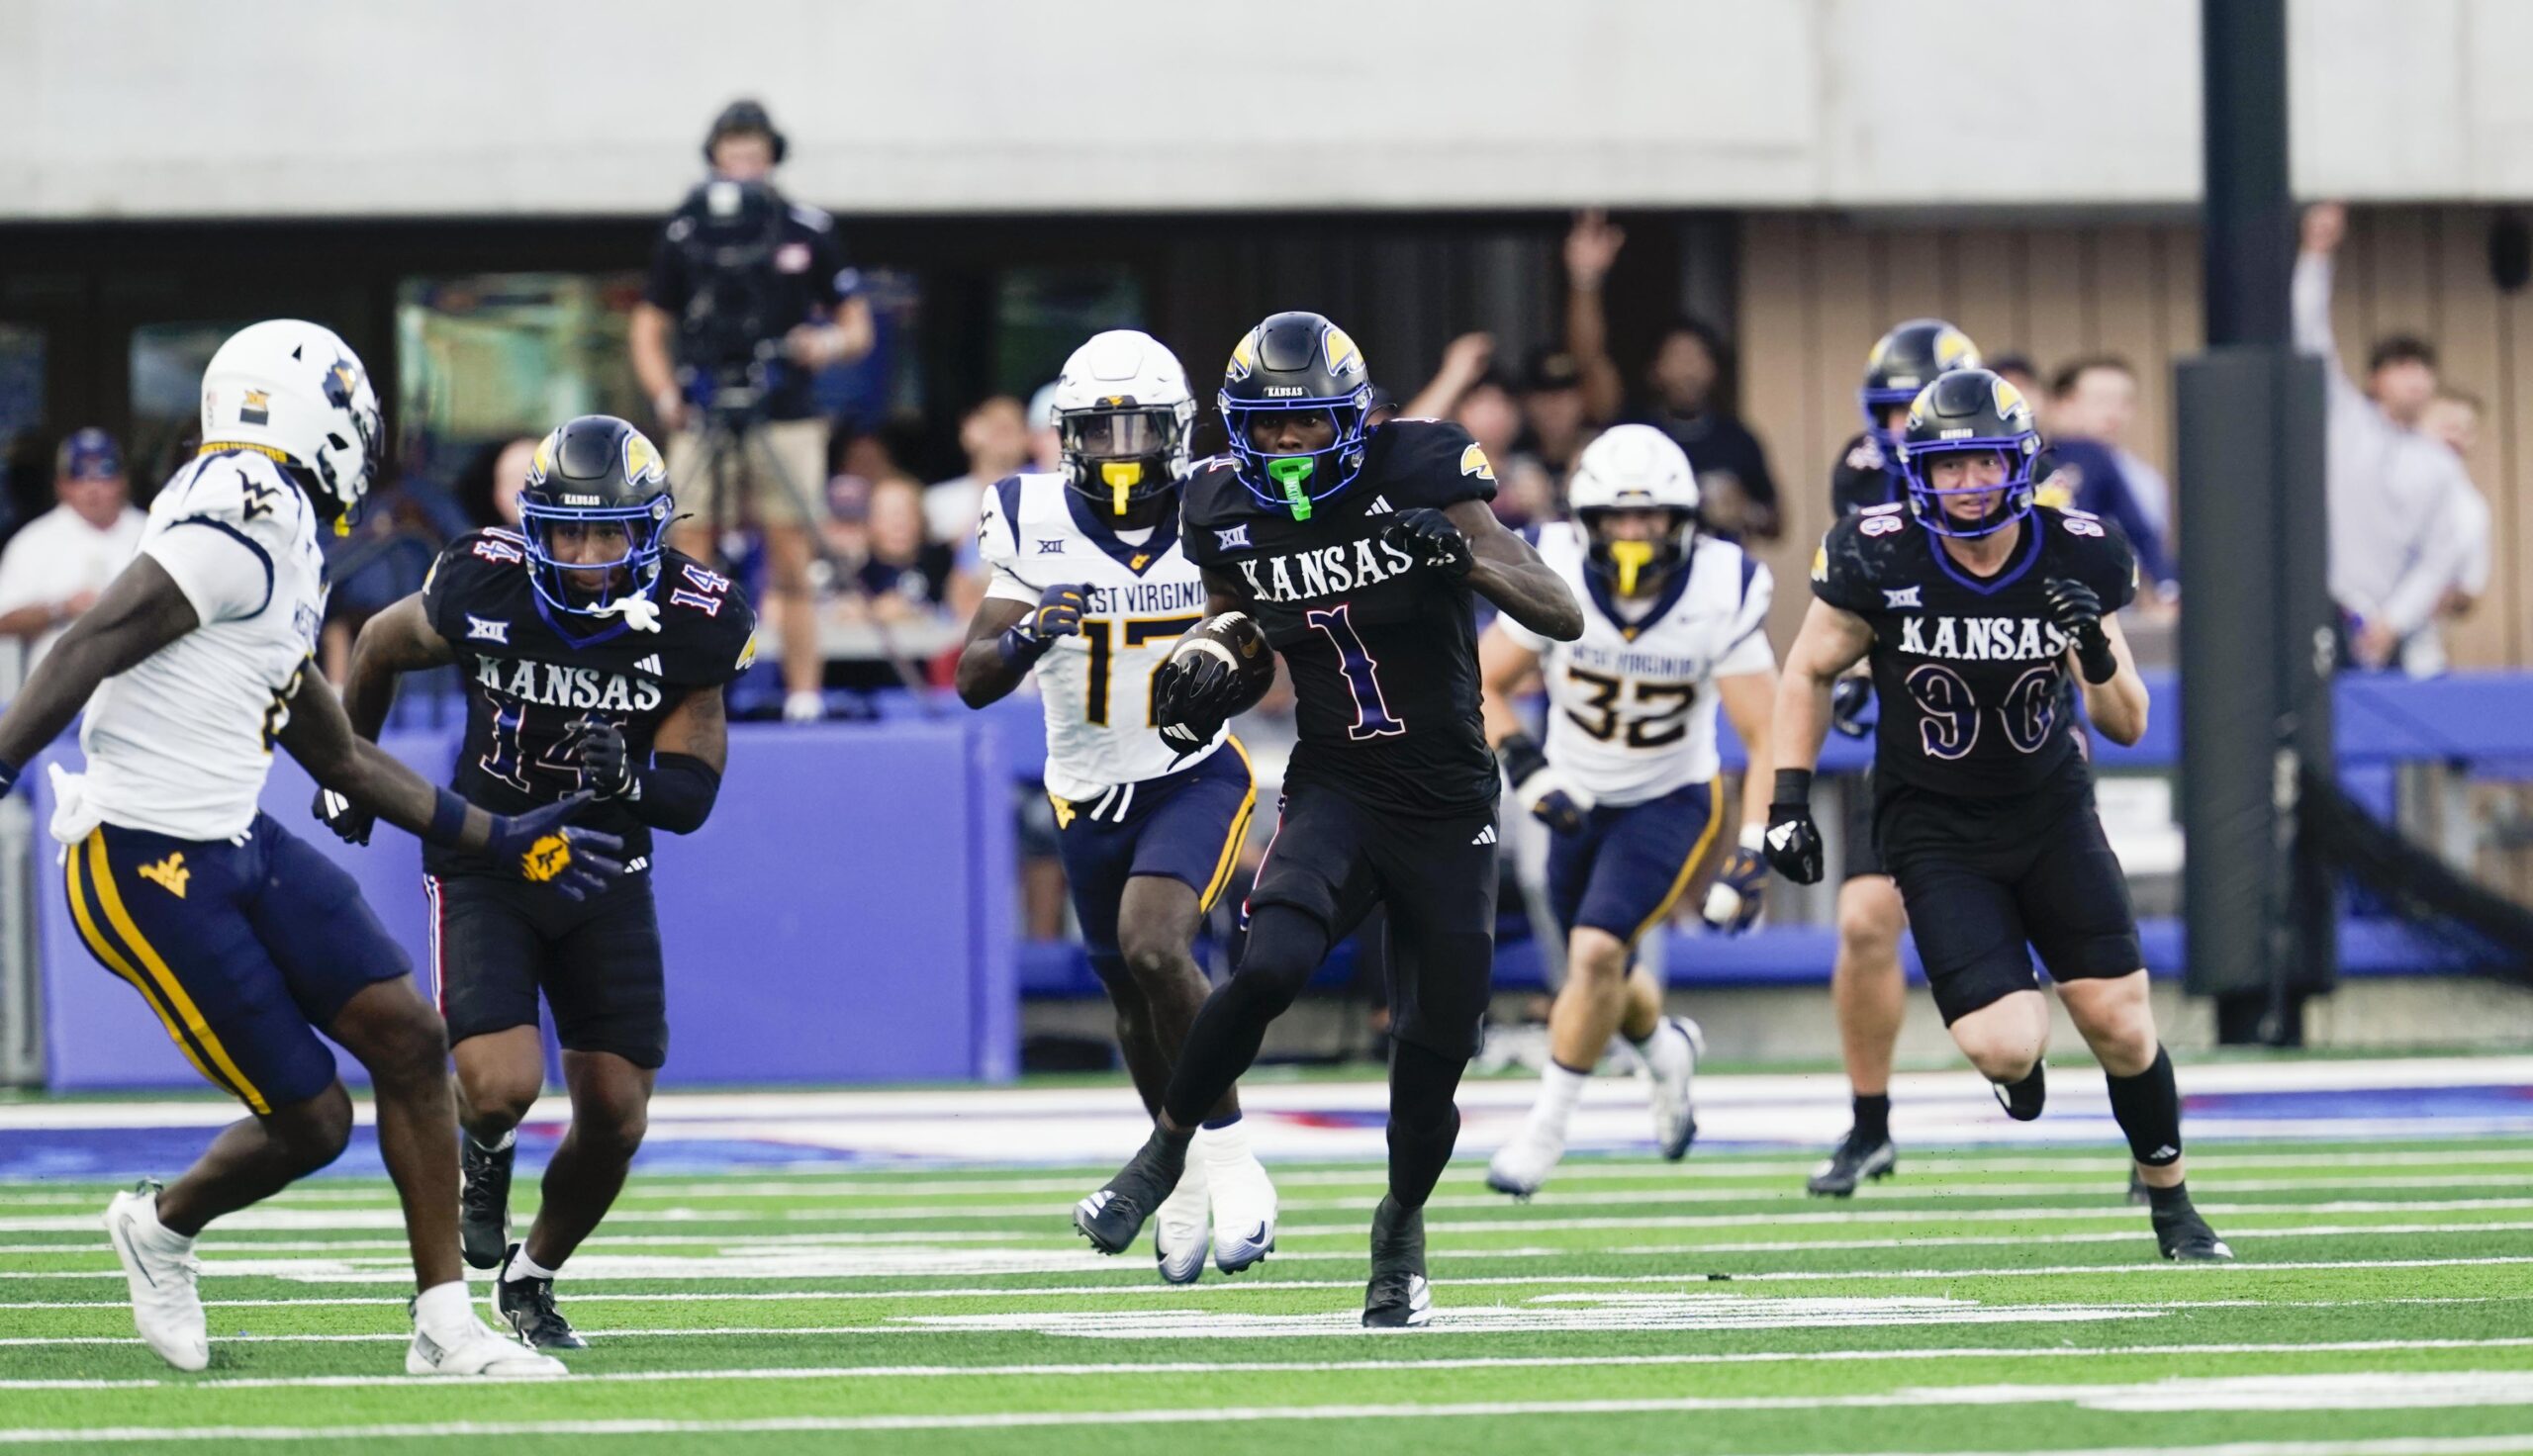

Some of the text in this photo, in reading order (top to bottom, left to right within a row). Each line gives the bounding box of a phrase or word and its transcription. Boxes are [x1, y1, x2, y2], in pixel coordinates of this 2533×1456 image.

[1267, 387, 1303, 397] KANSAS
[564, 494, 601, 506] KANSAS
[1037, 538, 1066, 554] XII
[1213, 523, 1254, 551] XII
[1237, 538, 1414, 602] KANSAS
[670, 564, 730, 617] 14
[1124, 581, 1206, 612] VIRGINI
[1882, 586, 1923, 609] XII
[466, 613, 510, 644] XII
[1898, 616, 2068, 661] KANSAS
[474, 653, 663, 712] KANSAS
[1079, 612, 1203, 729] 17
[1306, 602, 1407, 741] 1
[1567, 666, 1699, 749] 32
